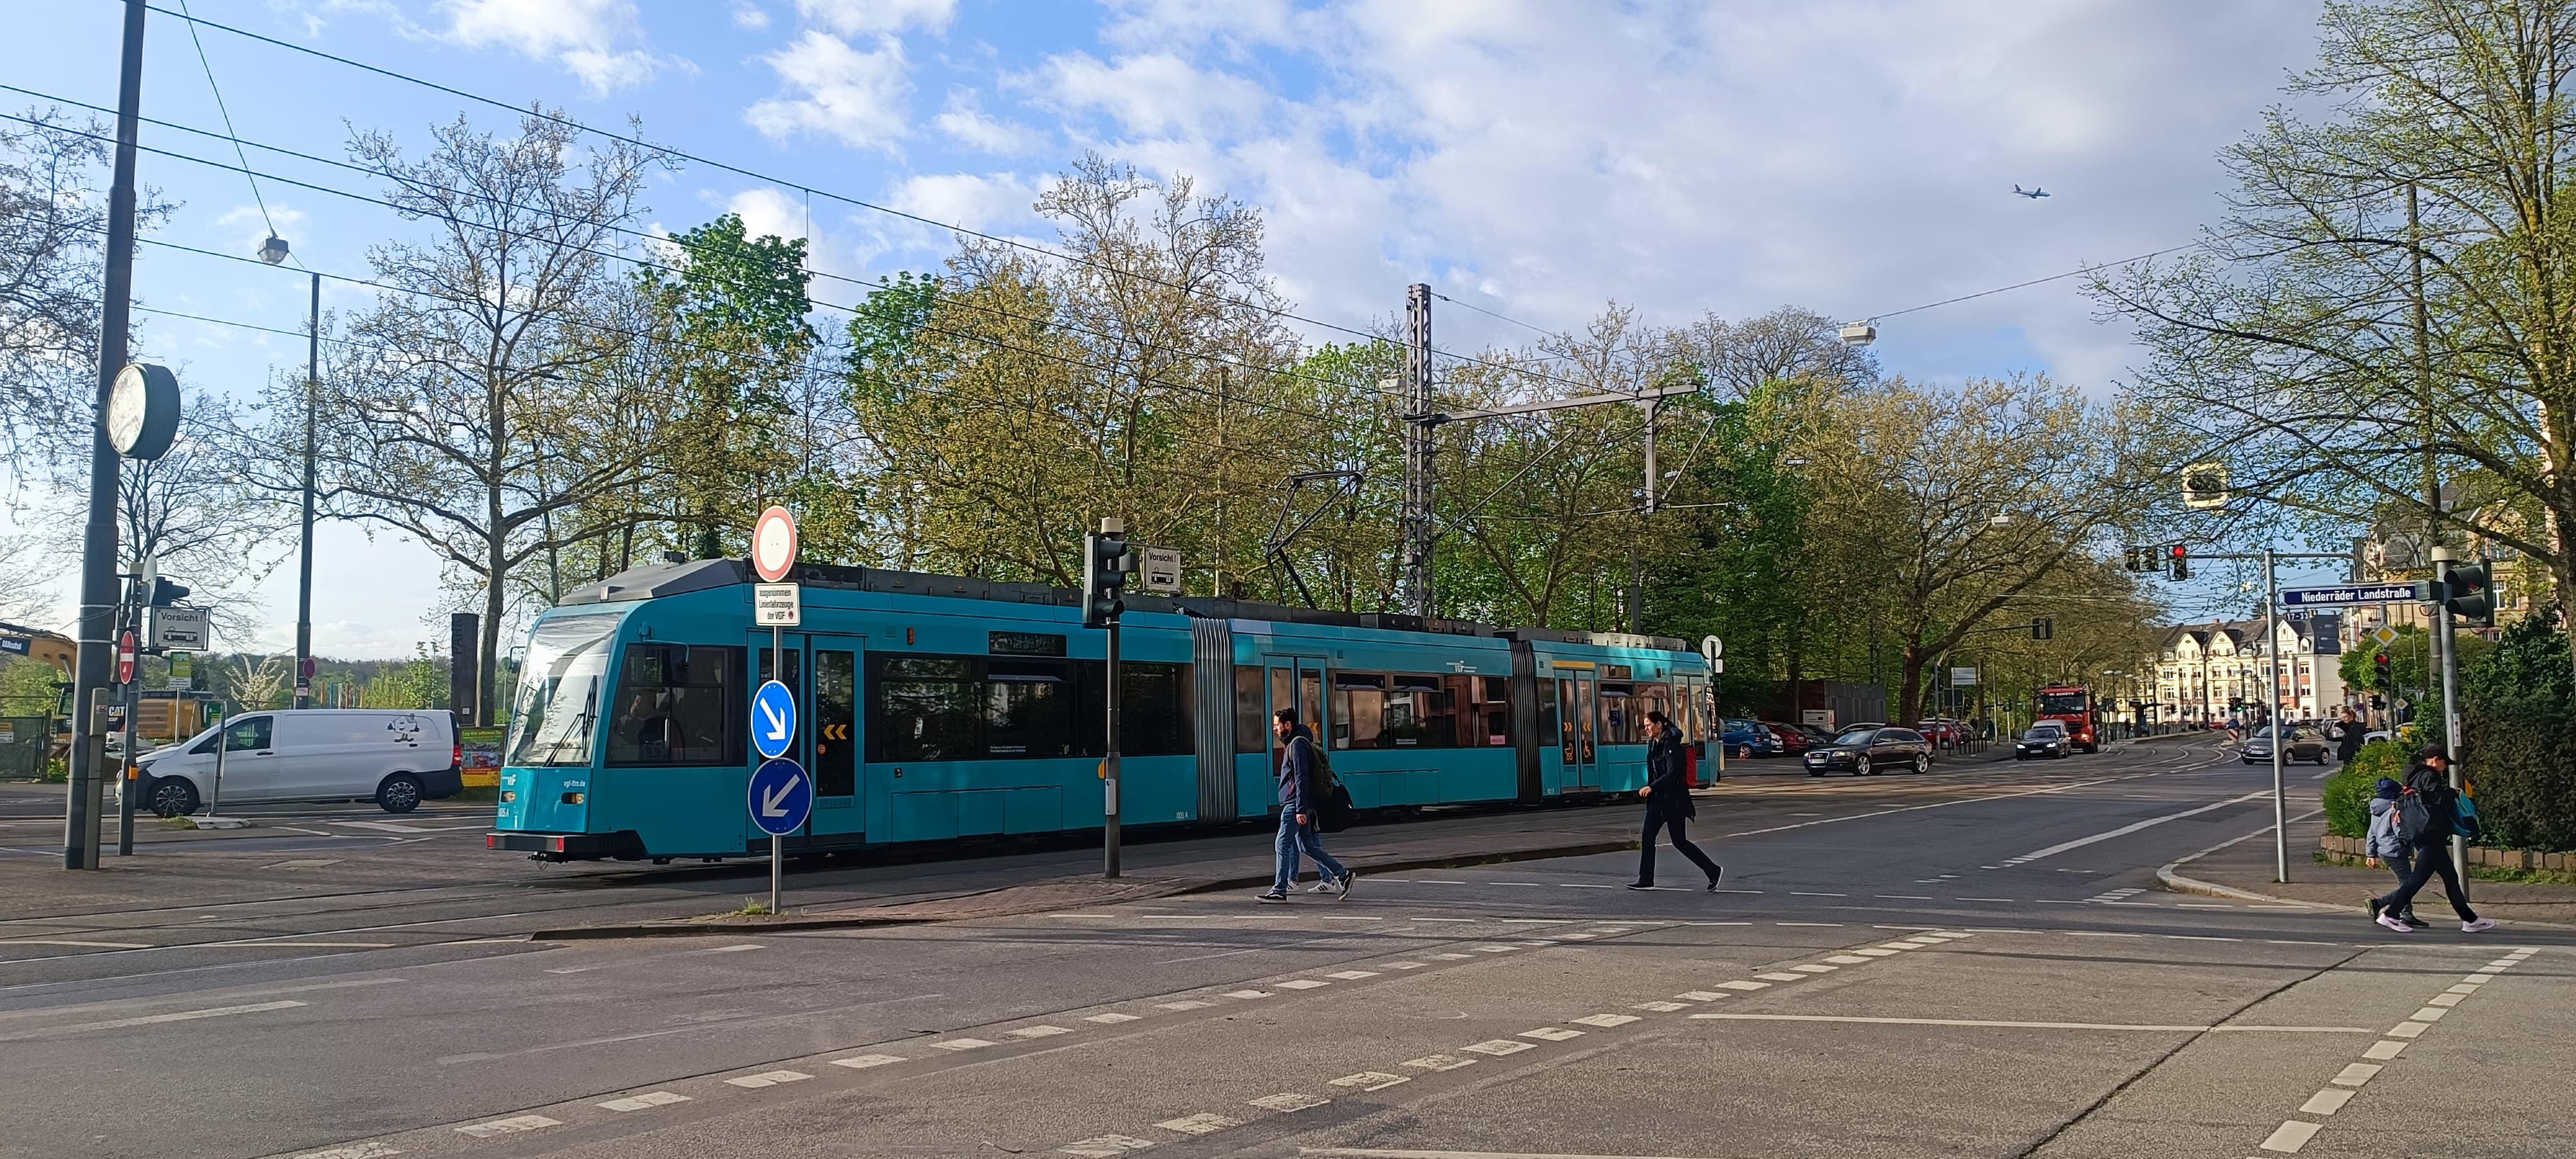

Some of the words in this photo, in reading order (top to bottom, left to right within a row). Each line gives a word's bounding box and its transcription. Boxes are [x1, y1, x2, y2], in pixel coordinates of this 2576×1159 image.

[2301, 590, 2355, 603] Niederräder
[2358, 587, 2411, 600] Landstraße
[775, 611, 785, 619] VGF
[109, 706, 125, 716] CAT
